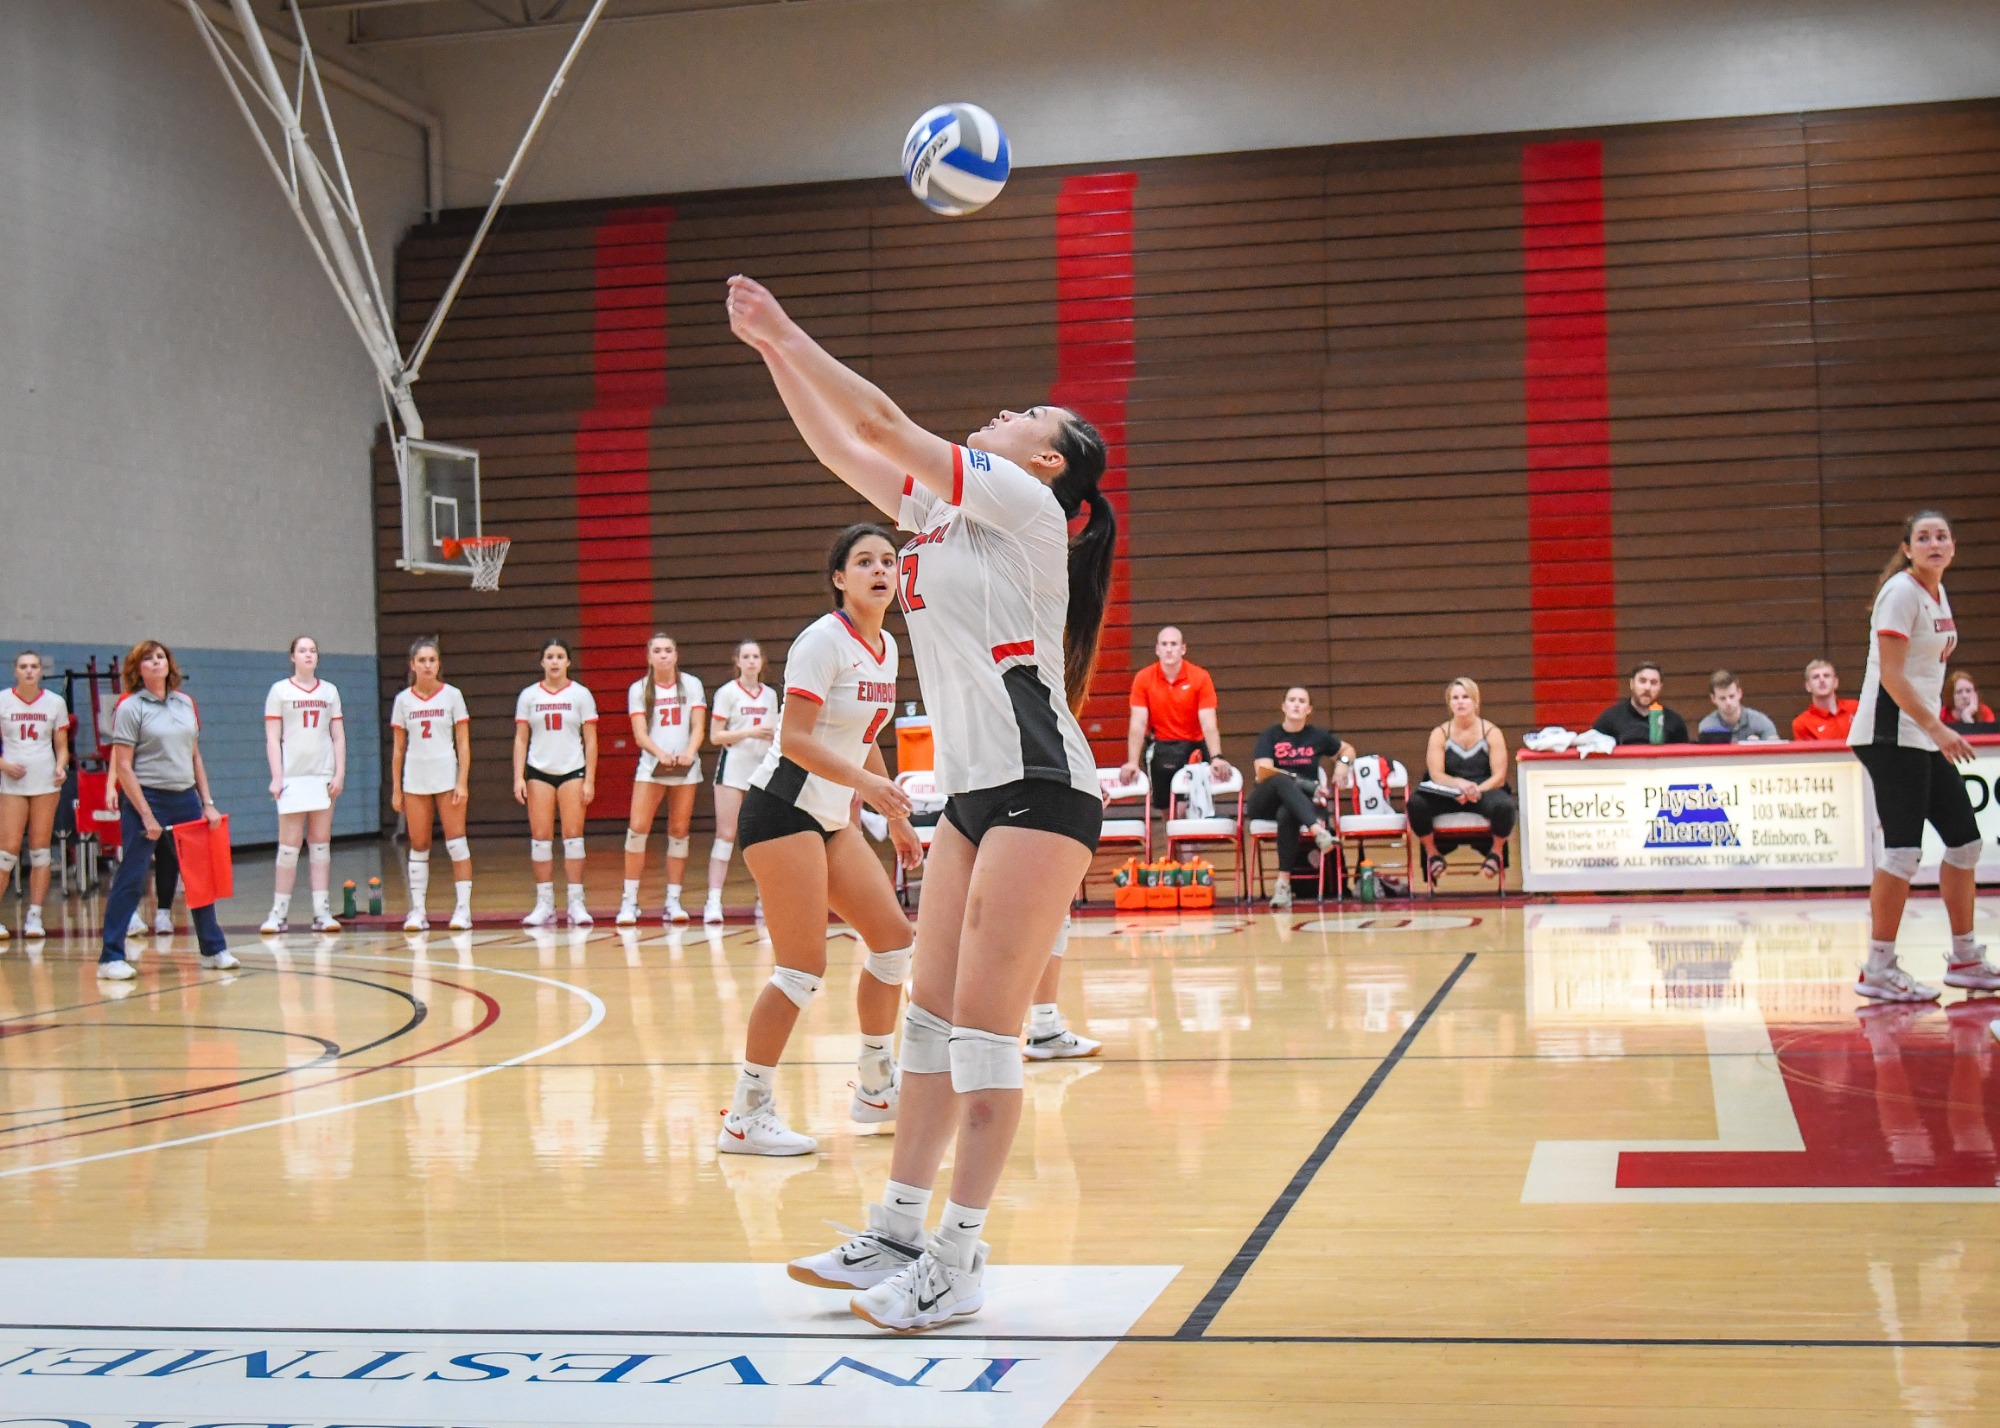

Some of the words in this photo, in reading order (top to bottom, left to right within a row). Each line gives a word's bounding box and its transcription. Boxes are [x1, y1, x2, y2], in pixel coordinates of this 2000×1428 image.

[857, 681, 897, 703] EDINBO
[303, 710, 320, 728] 17
[20, 724, 39, 740] 14
[421, 720, 432, 739] 2
[1750, 777, 1834, 795] 814-734-7444
[1548, 793, 1625, 818] Eberle's
[1644, 785, 1738, 815] Physical
[1752, 803, 1773, 819] 103
[1777, 802, 1817, 818] Walker
[1822, 801, 1839, 818] Dr.
[1646, 819, 1739, 846] Therapy
[1814, 828, 1832, 845] Pa.
[1545, 856, 1619, 868] "PROVIDING
[1623, 857, 1646, 867] ALL
[1650, 855, 1710, 867] PHYSICAL
[1714, 853, 1771, 866] THERAPY
[1775, 851, 1838, 864] SERVICES"
